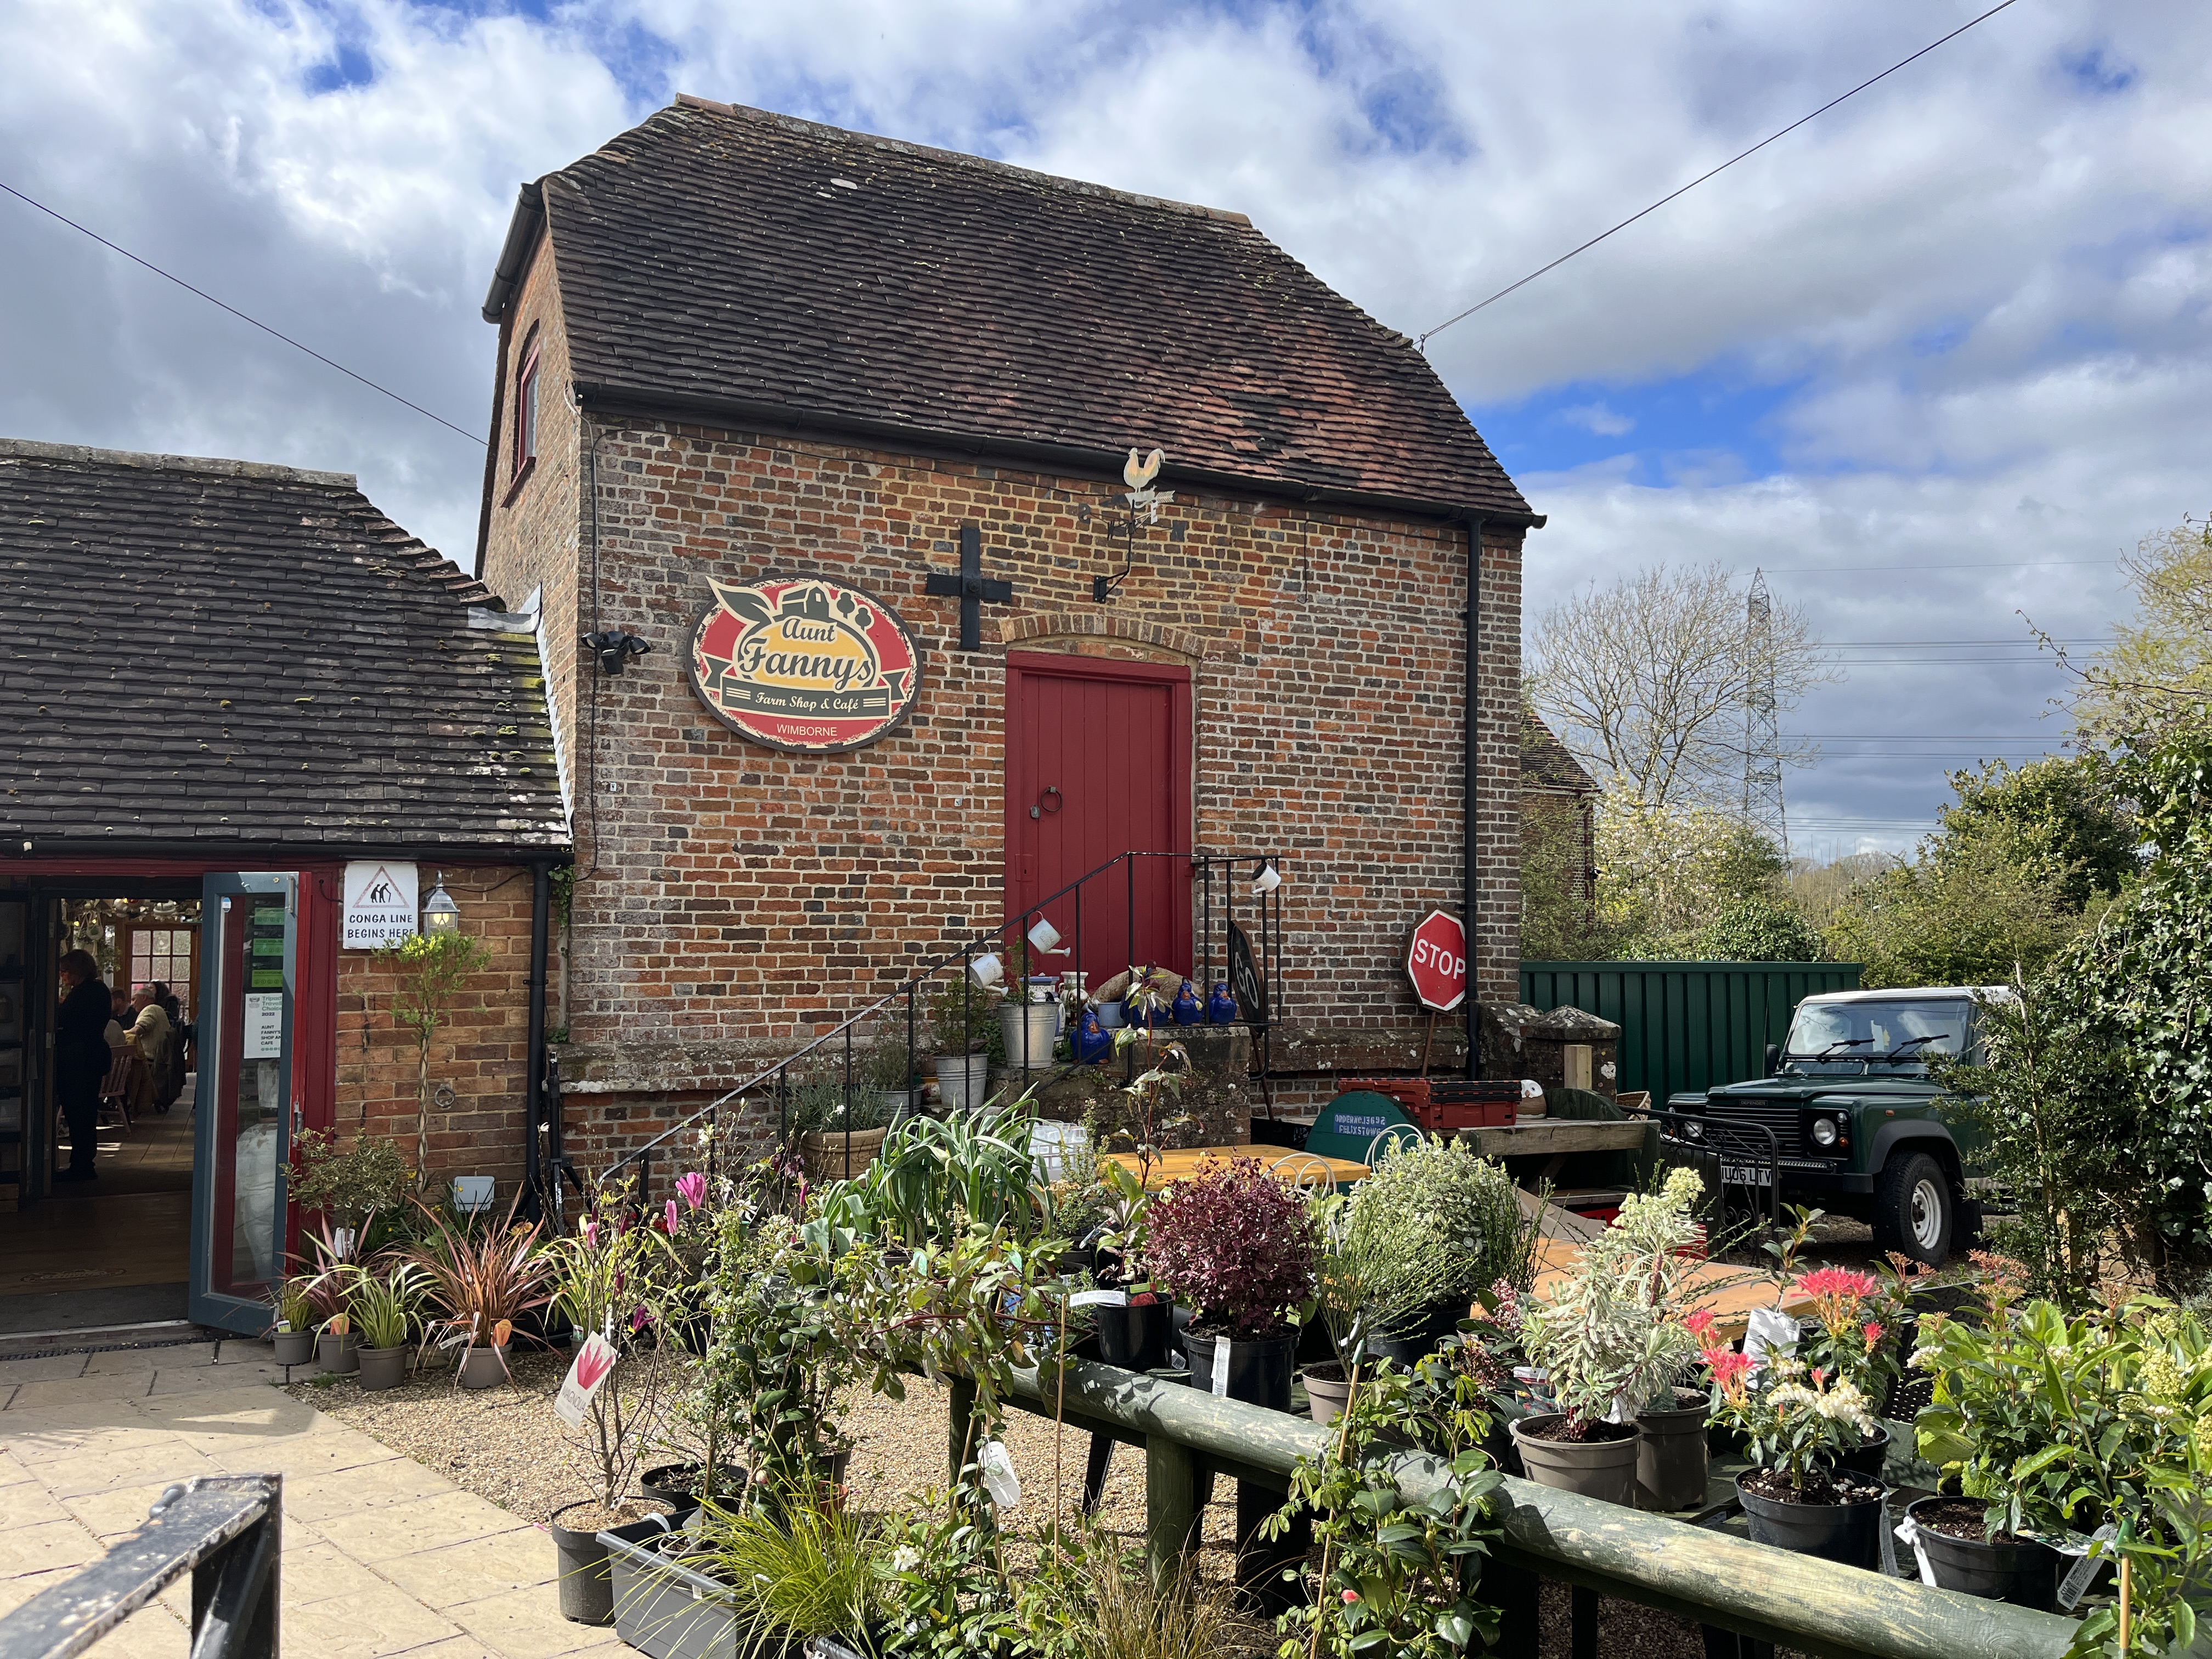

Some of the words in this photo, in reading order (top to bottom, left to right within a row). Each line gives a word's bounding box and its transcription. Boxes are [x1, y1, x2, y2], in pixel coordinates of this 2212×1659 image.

[782, 618, 836, 642] Aunt
[740, 638, 873, 691] Fannys
[755, 692, 786, 707] Farm
[789, 695, 817, 712] Shop
[821, 697, 829, 709] &
[833, 697, 859, 713] Café
[776, 724, 838, 736] WIMBORNE
[349, 915, 386, 923] CONGA
[391, 915, 413, 923] LINE
[348, 929, 385, 938] BEGINS
[1414, 939, 1465, 980] STOP
[1235, 952, 1259, 1009] GO
[562, 1385, 586, 1413] MAGNOLIA
